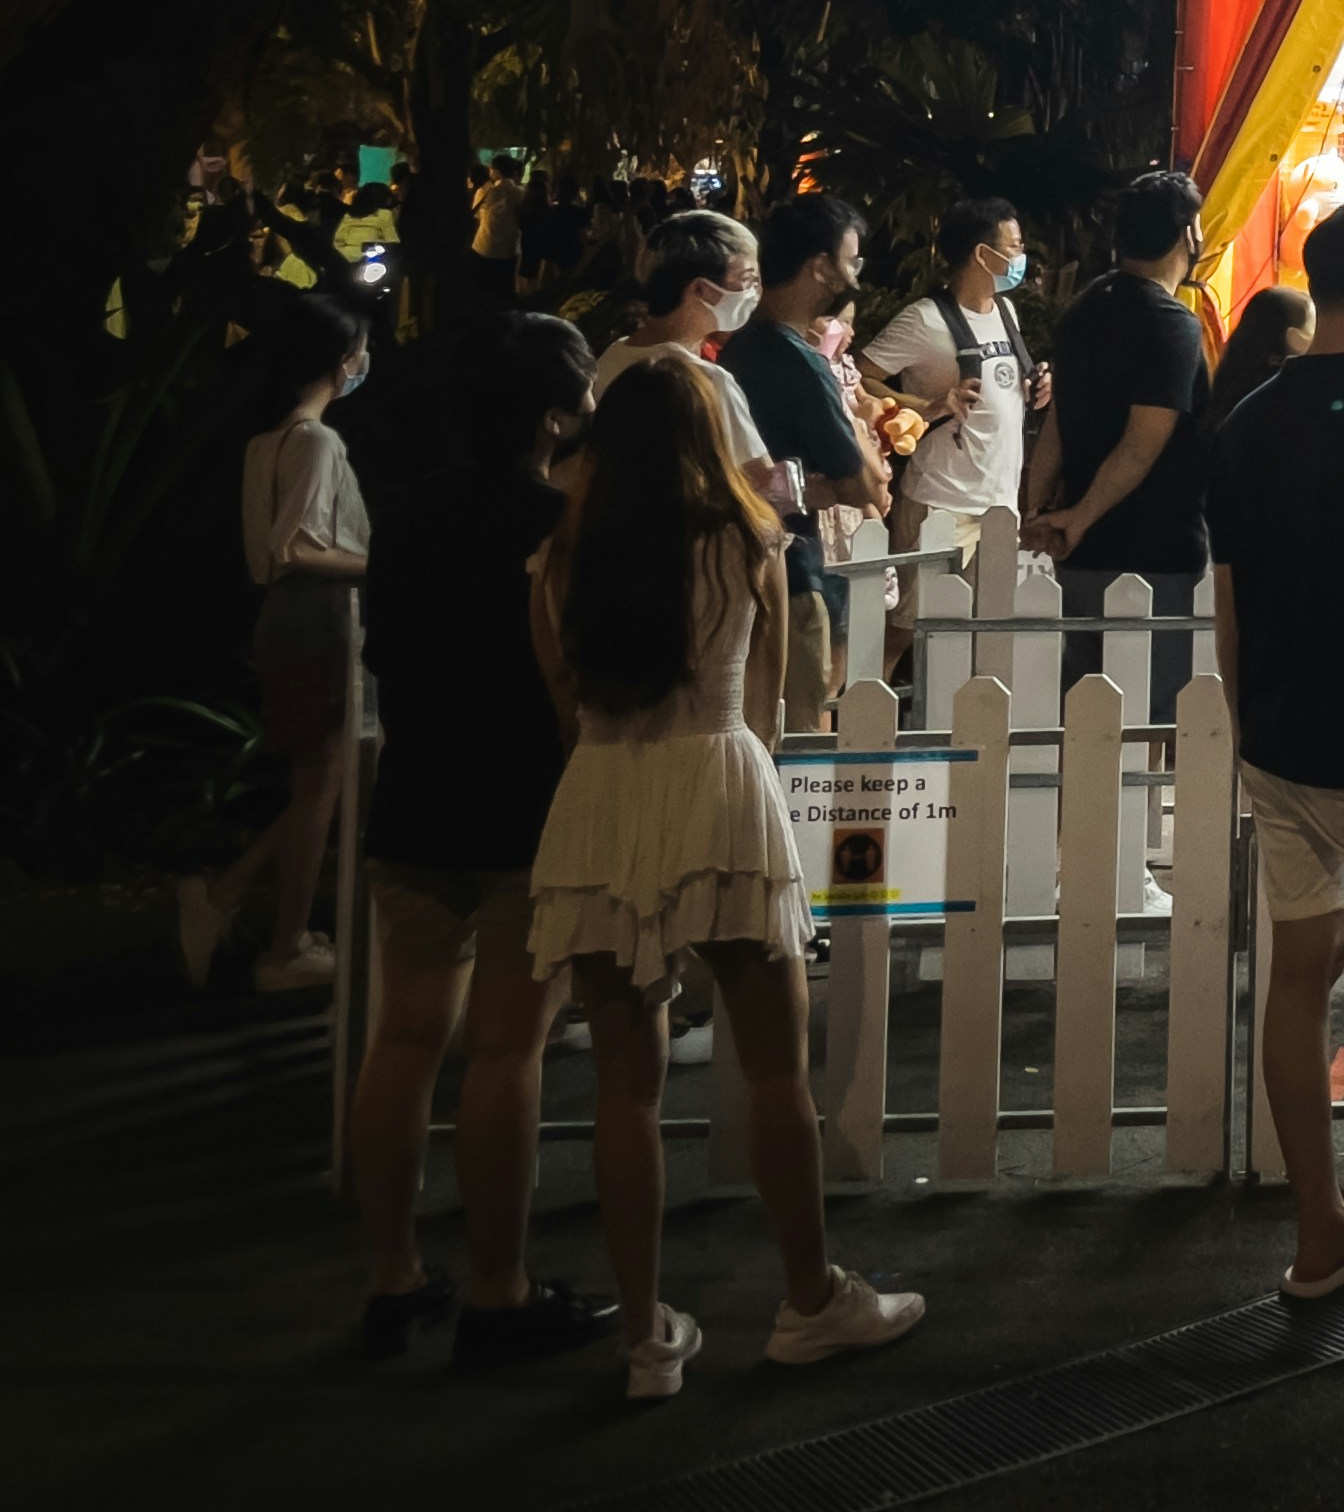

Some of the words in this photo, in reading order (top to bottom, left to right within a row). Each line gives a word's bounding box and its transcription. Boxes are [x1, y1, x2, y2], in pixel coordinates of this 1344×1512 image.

[790, 776, 854, 794] Please
[860, 774, 909, 795] keep
[915, 777, 926, 791] a
[807, 804, 892, 822] Distance
[898, 802, 920, 820] of
[926, 802, 957, 820] 1m
